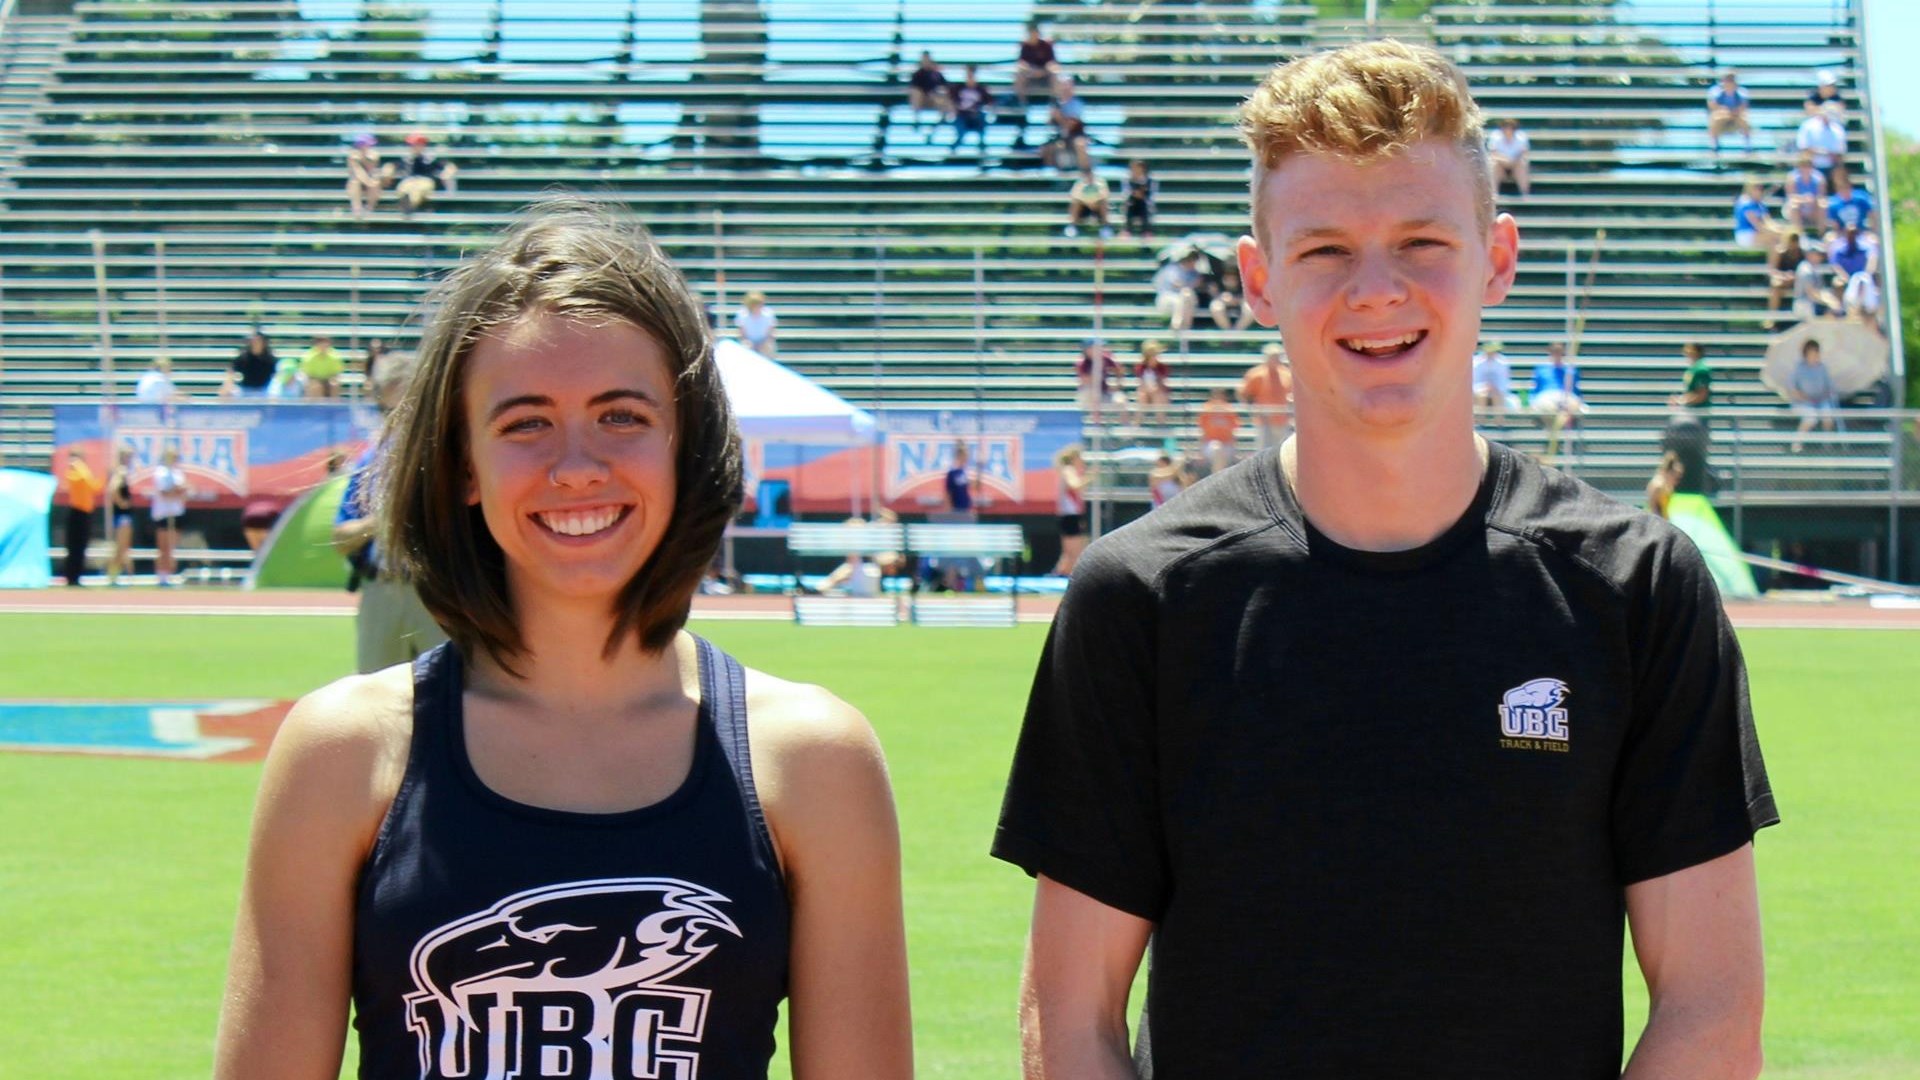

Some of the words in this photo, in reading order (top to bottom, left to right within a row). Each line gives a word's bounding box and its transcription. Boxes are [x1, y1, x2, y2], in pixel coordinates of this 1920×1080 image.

[1498, 704, 1569, 741] UBC
[1500, 739, 1532, 750] TRACK
[1534, 741, 1542, 750] &
[1543, 741, 1569, 752] FIELD
[403, 986, 712, 1080] UBC
